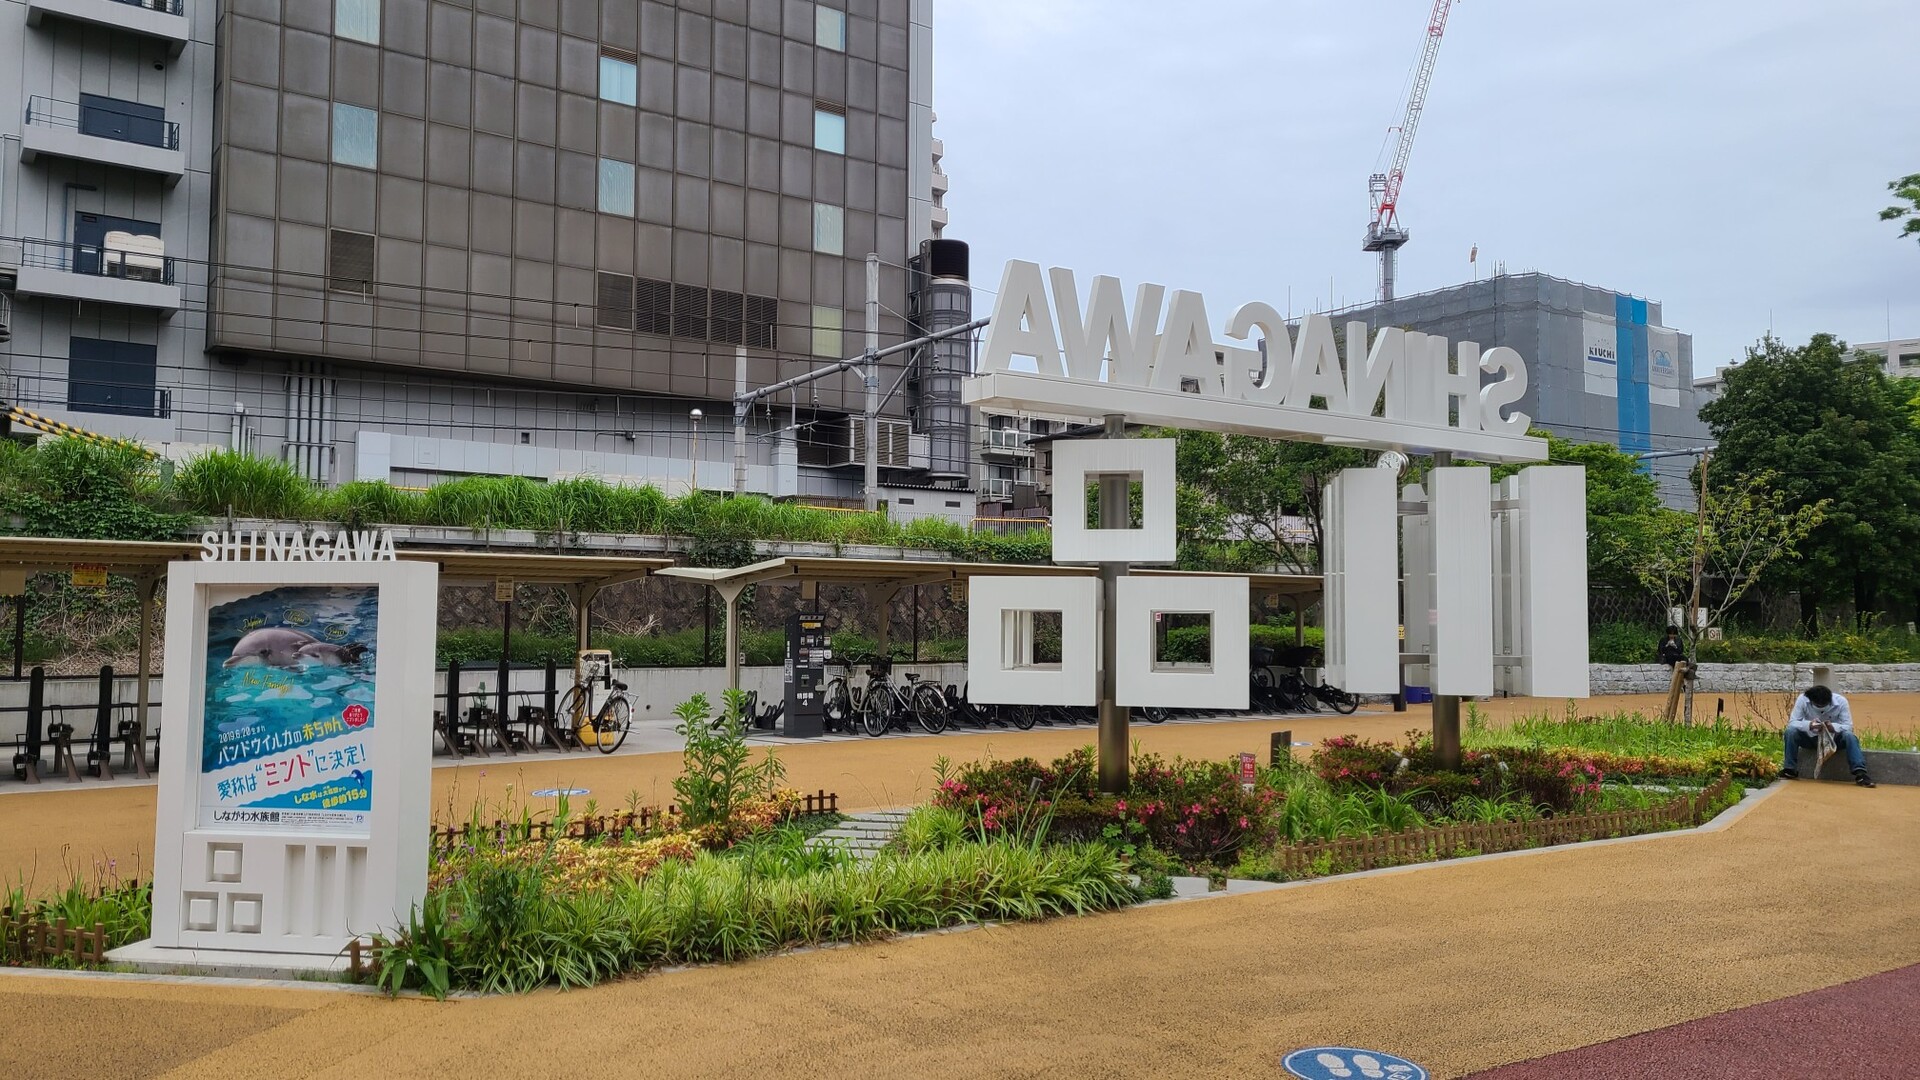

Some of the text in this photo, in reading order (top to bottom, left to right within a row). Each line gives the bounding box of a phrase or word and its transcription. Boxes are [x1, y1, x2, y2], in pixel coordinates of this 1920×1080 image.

[1589, 347, 1615, 359] KIUCHI
[200, 530, 397, 562] SHINAGAWA
[242, 669, 260, 687] New
[218, 716, 343, 765] バンドウイルカの赤ちゃん
[213, 809, 280, 823] しながわ水族館
